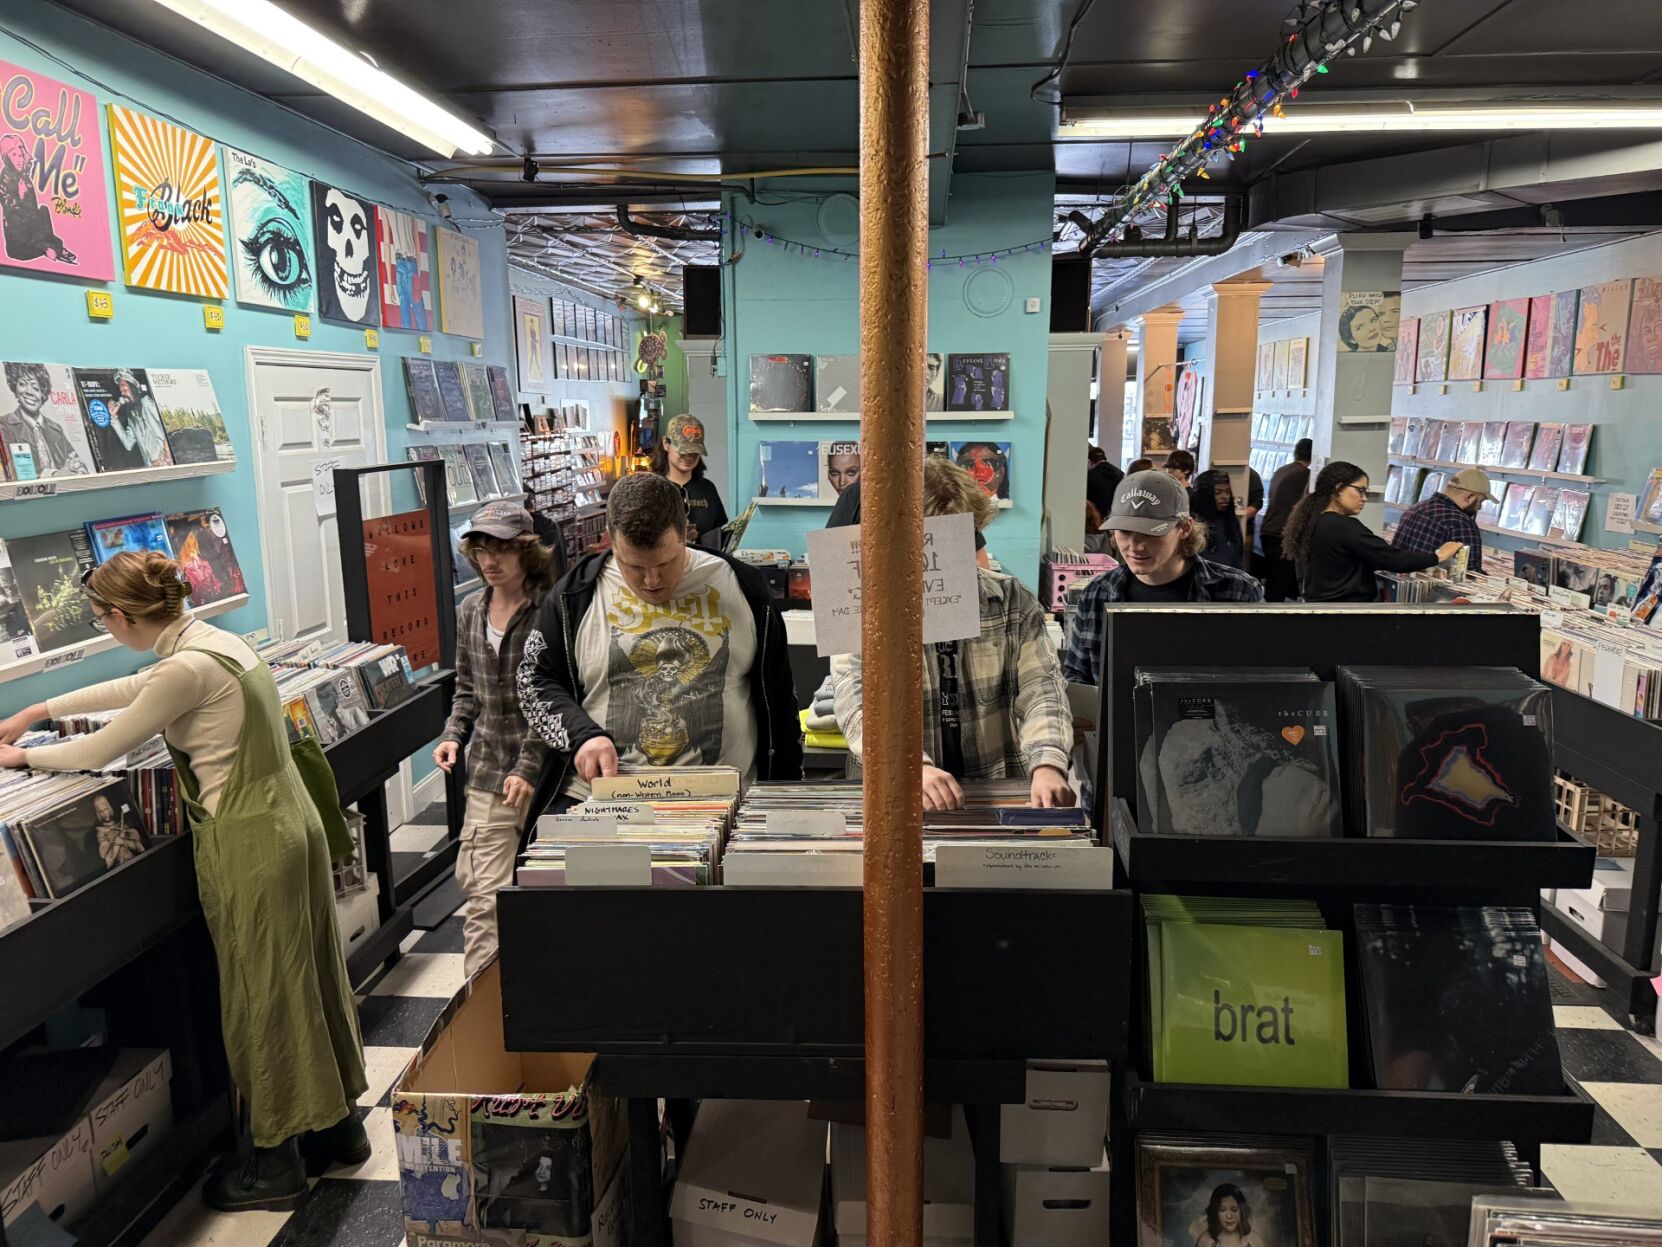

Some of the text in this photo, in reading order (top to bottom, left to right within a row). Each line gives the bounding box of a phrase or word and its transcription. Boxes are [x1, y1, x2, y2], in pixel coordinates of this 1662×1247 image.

[232, 152, 243, 164] The
[147, 176, 213, 232] Black
[1120, 487, 1161, 506] Callaway
[368, 519, 424, 539] WALLOWS
[384, 554, 415, 571] LOVE
[387, 587, 418, 605] THIS
[383, 617, 429, 640] RECORD
[637, 778, 672, 789] World
[584, 805, 640, 815] NIGHTMARES
[1214, 990, 1295, 1046] brat
[698, 1198, 777, 1224] STAFF ONLY
